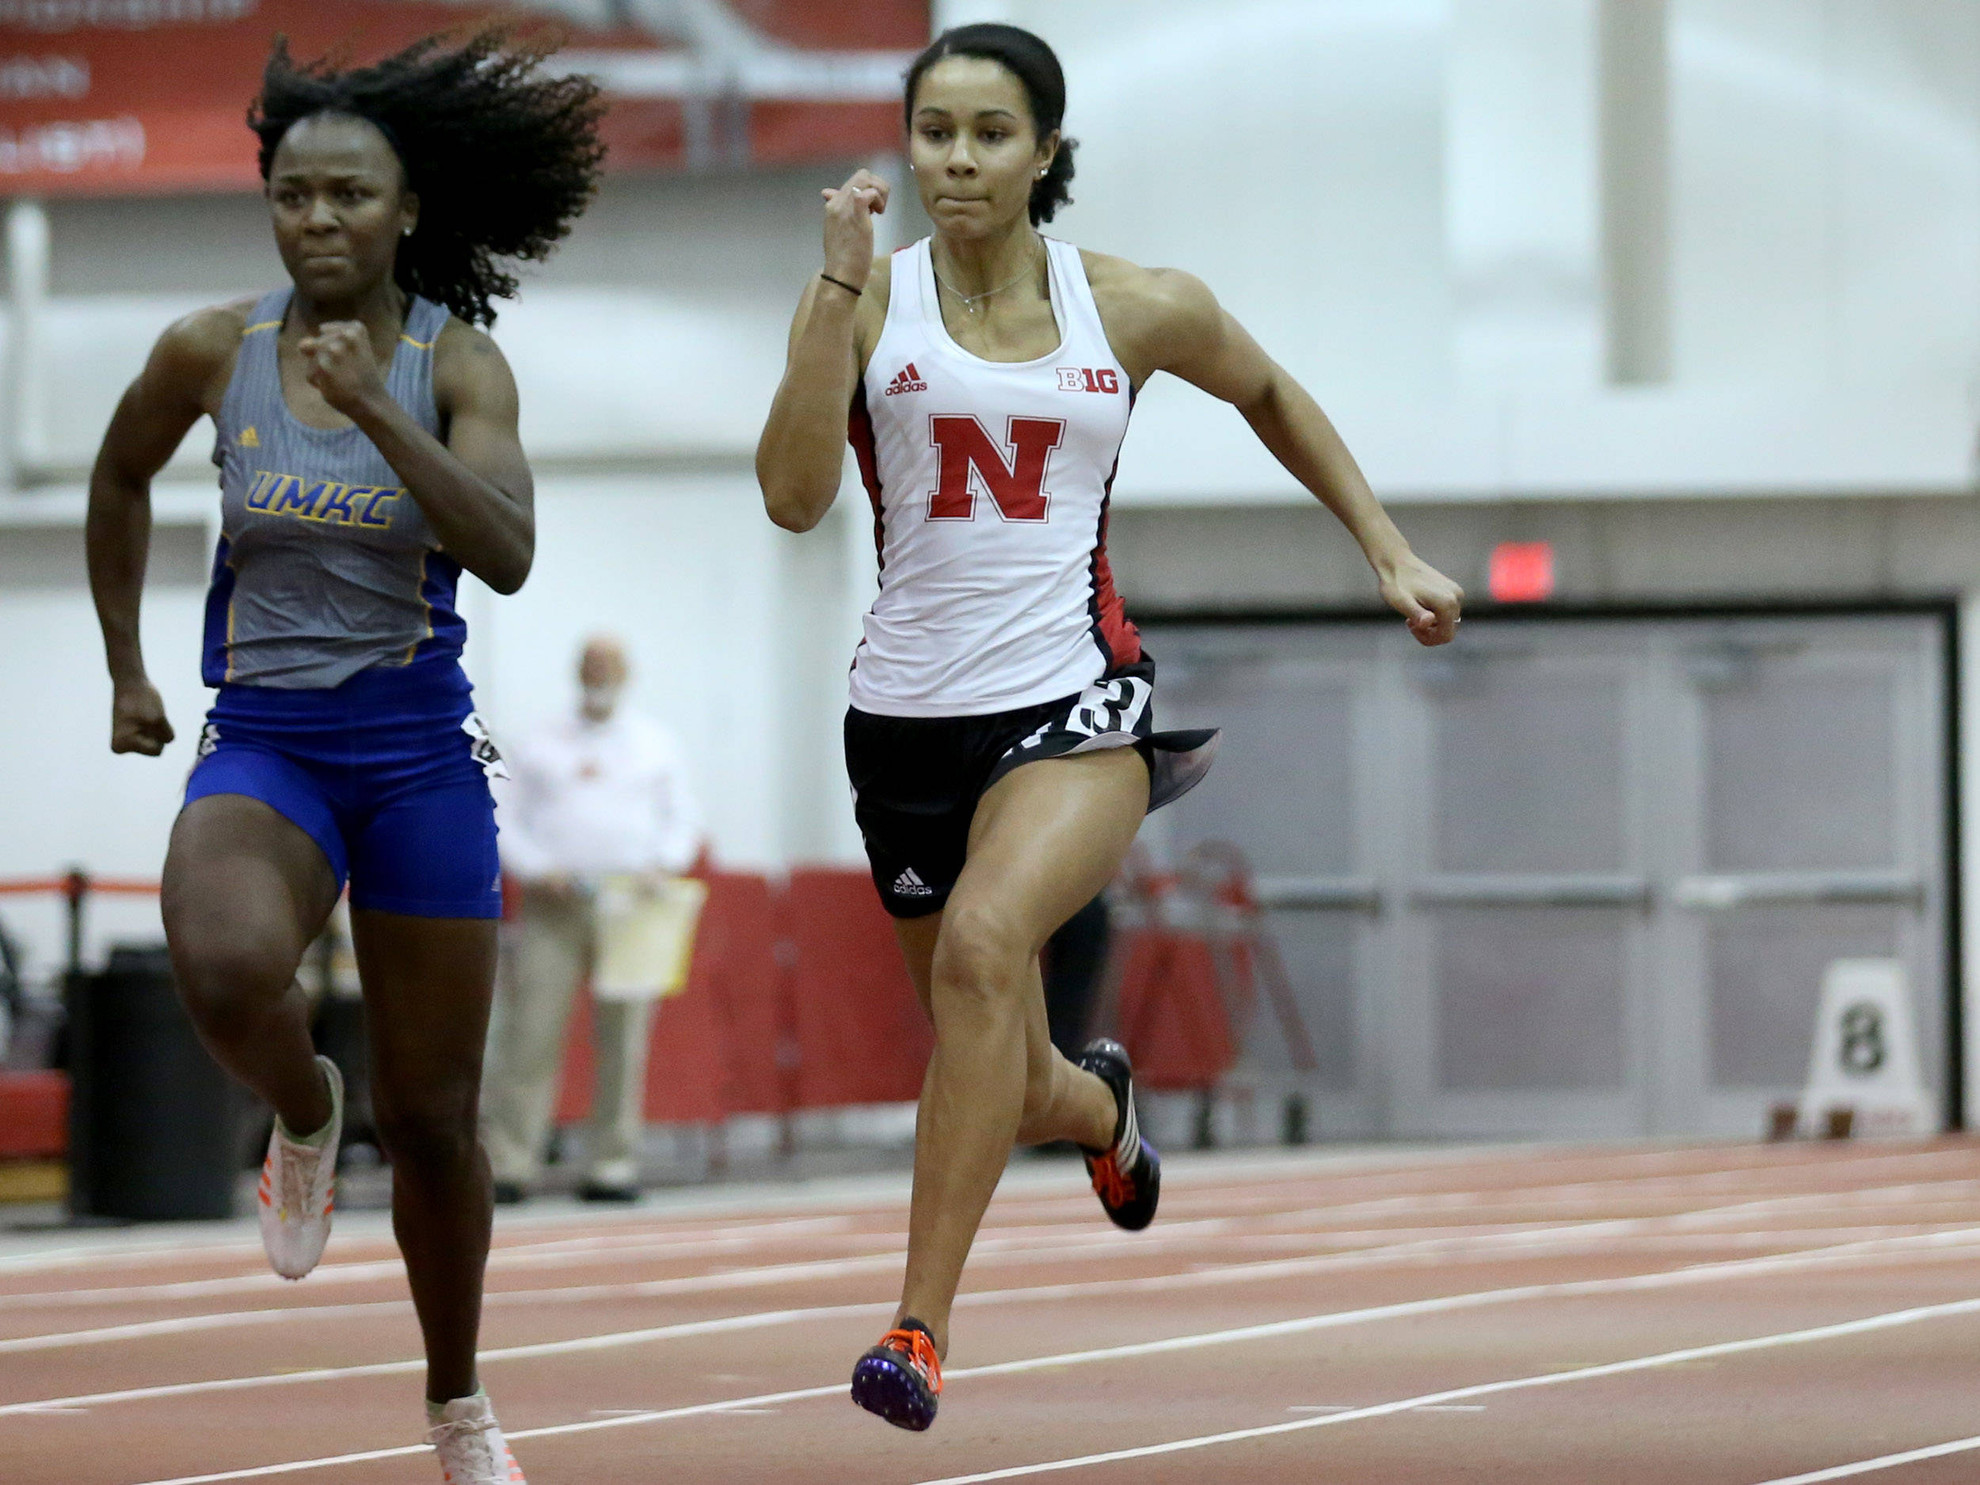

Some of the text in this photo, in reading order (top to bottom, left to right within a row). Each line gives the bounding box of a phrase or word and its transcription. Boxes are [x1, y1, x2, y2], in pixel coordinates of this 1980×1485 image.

[885, 381, 928, 396] adidas
[924, 413, 1067, 523] N
[246, 470, 408, 530] UMKC
[894, 884, 933, 895] adidas
[1840, 1002, 1886, 1078] 8
